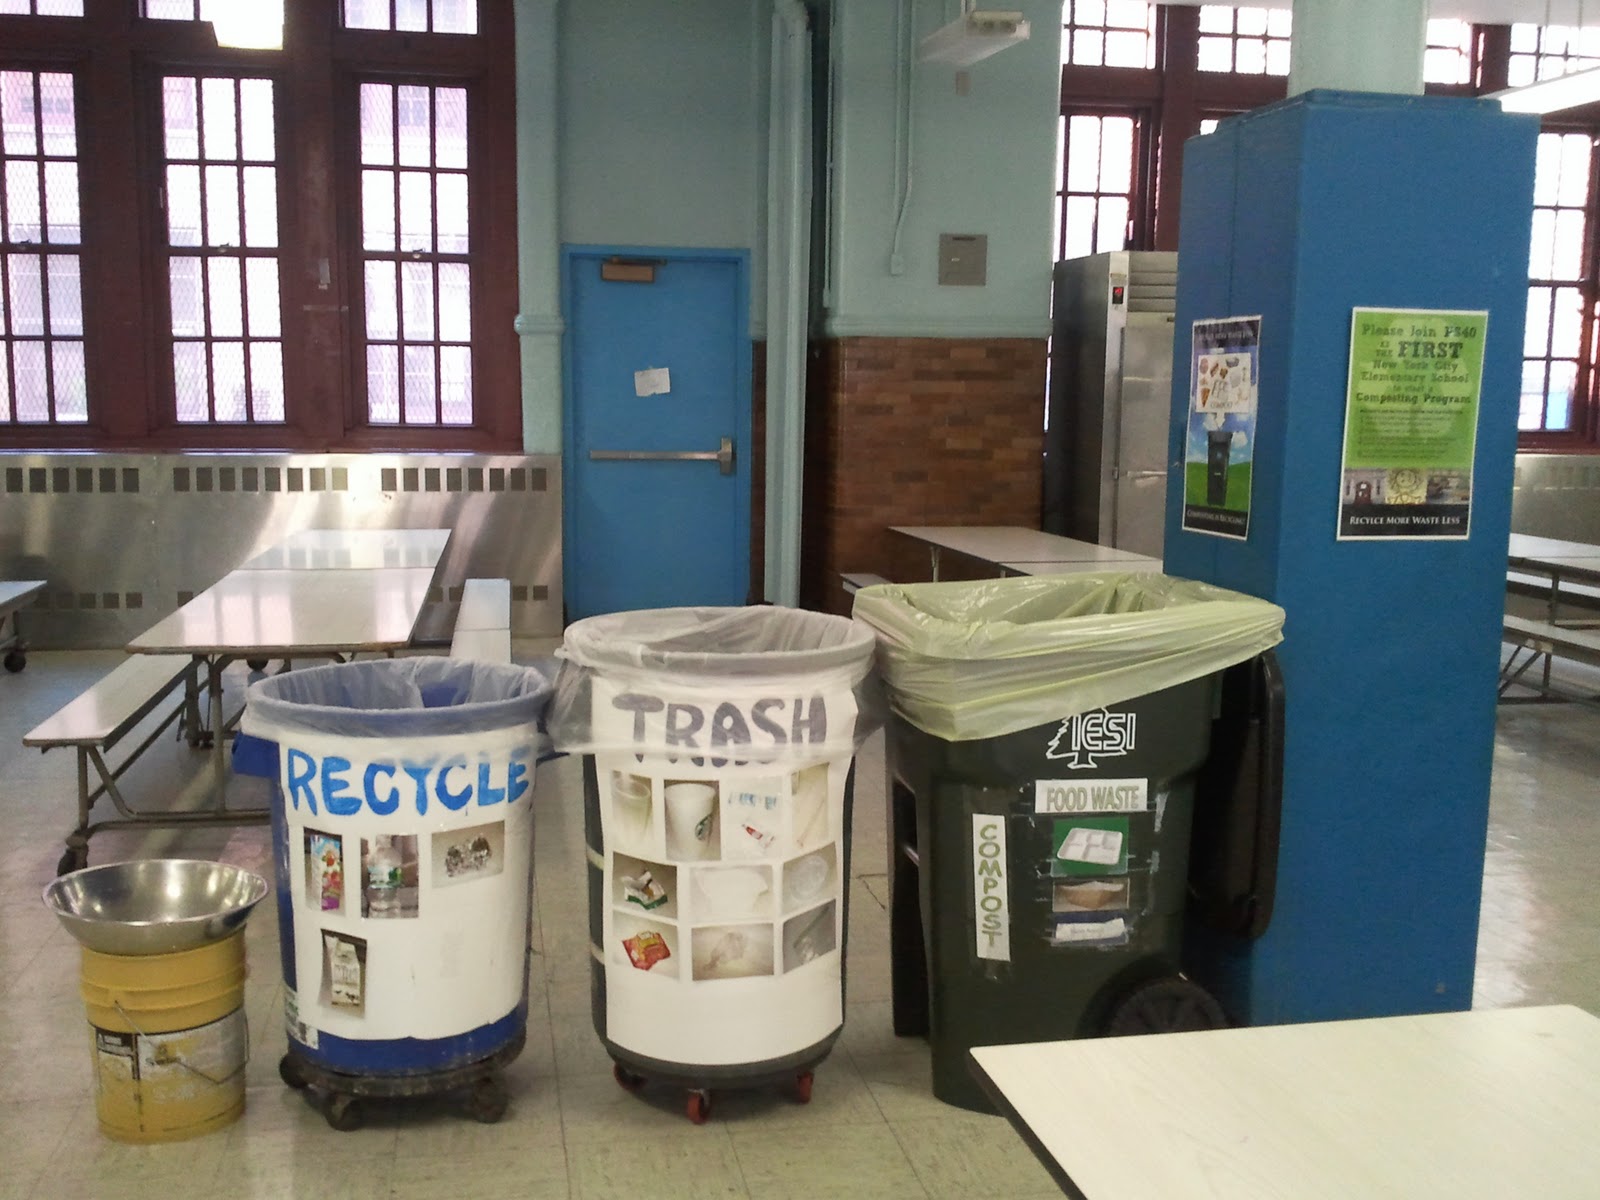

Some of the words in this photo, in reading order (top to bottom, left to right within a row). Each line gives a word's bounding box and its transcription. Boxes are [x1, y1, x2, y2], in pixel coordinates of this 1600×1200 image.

[1362, 324, 1403, 336] Please
[1410, 325, 1437, 337] Join
[1397, 340, 1464, 359] FIRST
[1373, 359, 1397, 369] New
[1403, 360, 1428, 370] York
[1434, 360, 1458, 373] City
[1361, 371, 1426, 384] Elementary
[1431, 371, 1469, 383] School
[1356, 393, 1418, 405] Composting
[1386, 516, 1410, 525] MORE
[1411, 516, 1440, 525] WASTE
[1441, 516, 1460, 525] LESS
[612, 692, 828, 767] TRASH
[287, 744, 531, 817] RECYCLE
[1046, 787, 1088, 811] FOOD
[1091, 785, 1140, 810] WASTE
[977, 824, 1003, 948] COMPOST
